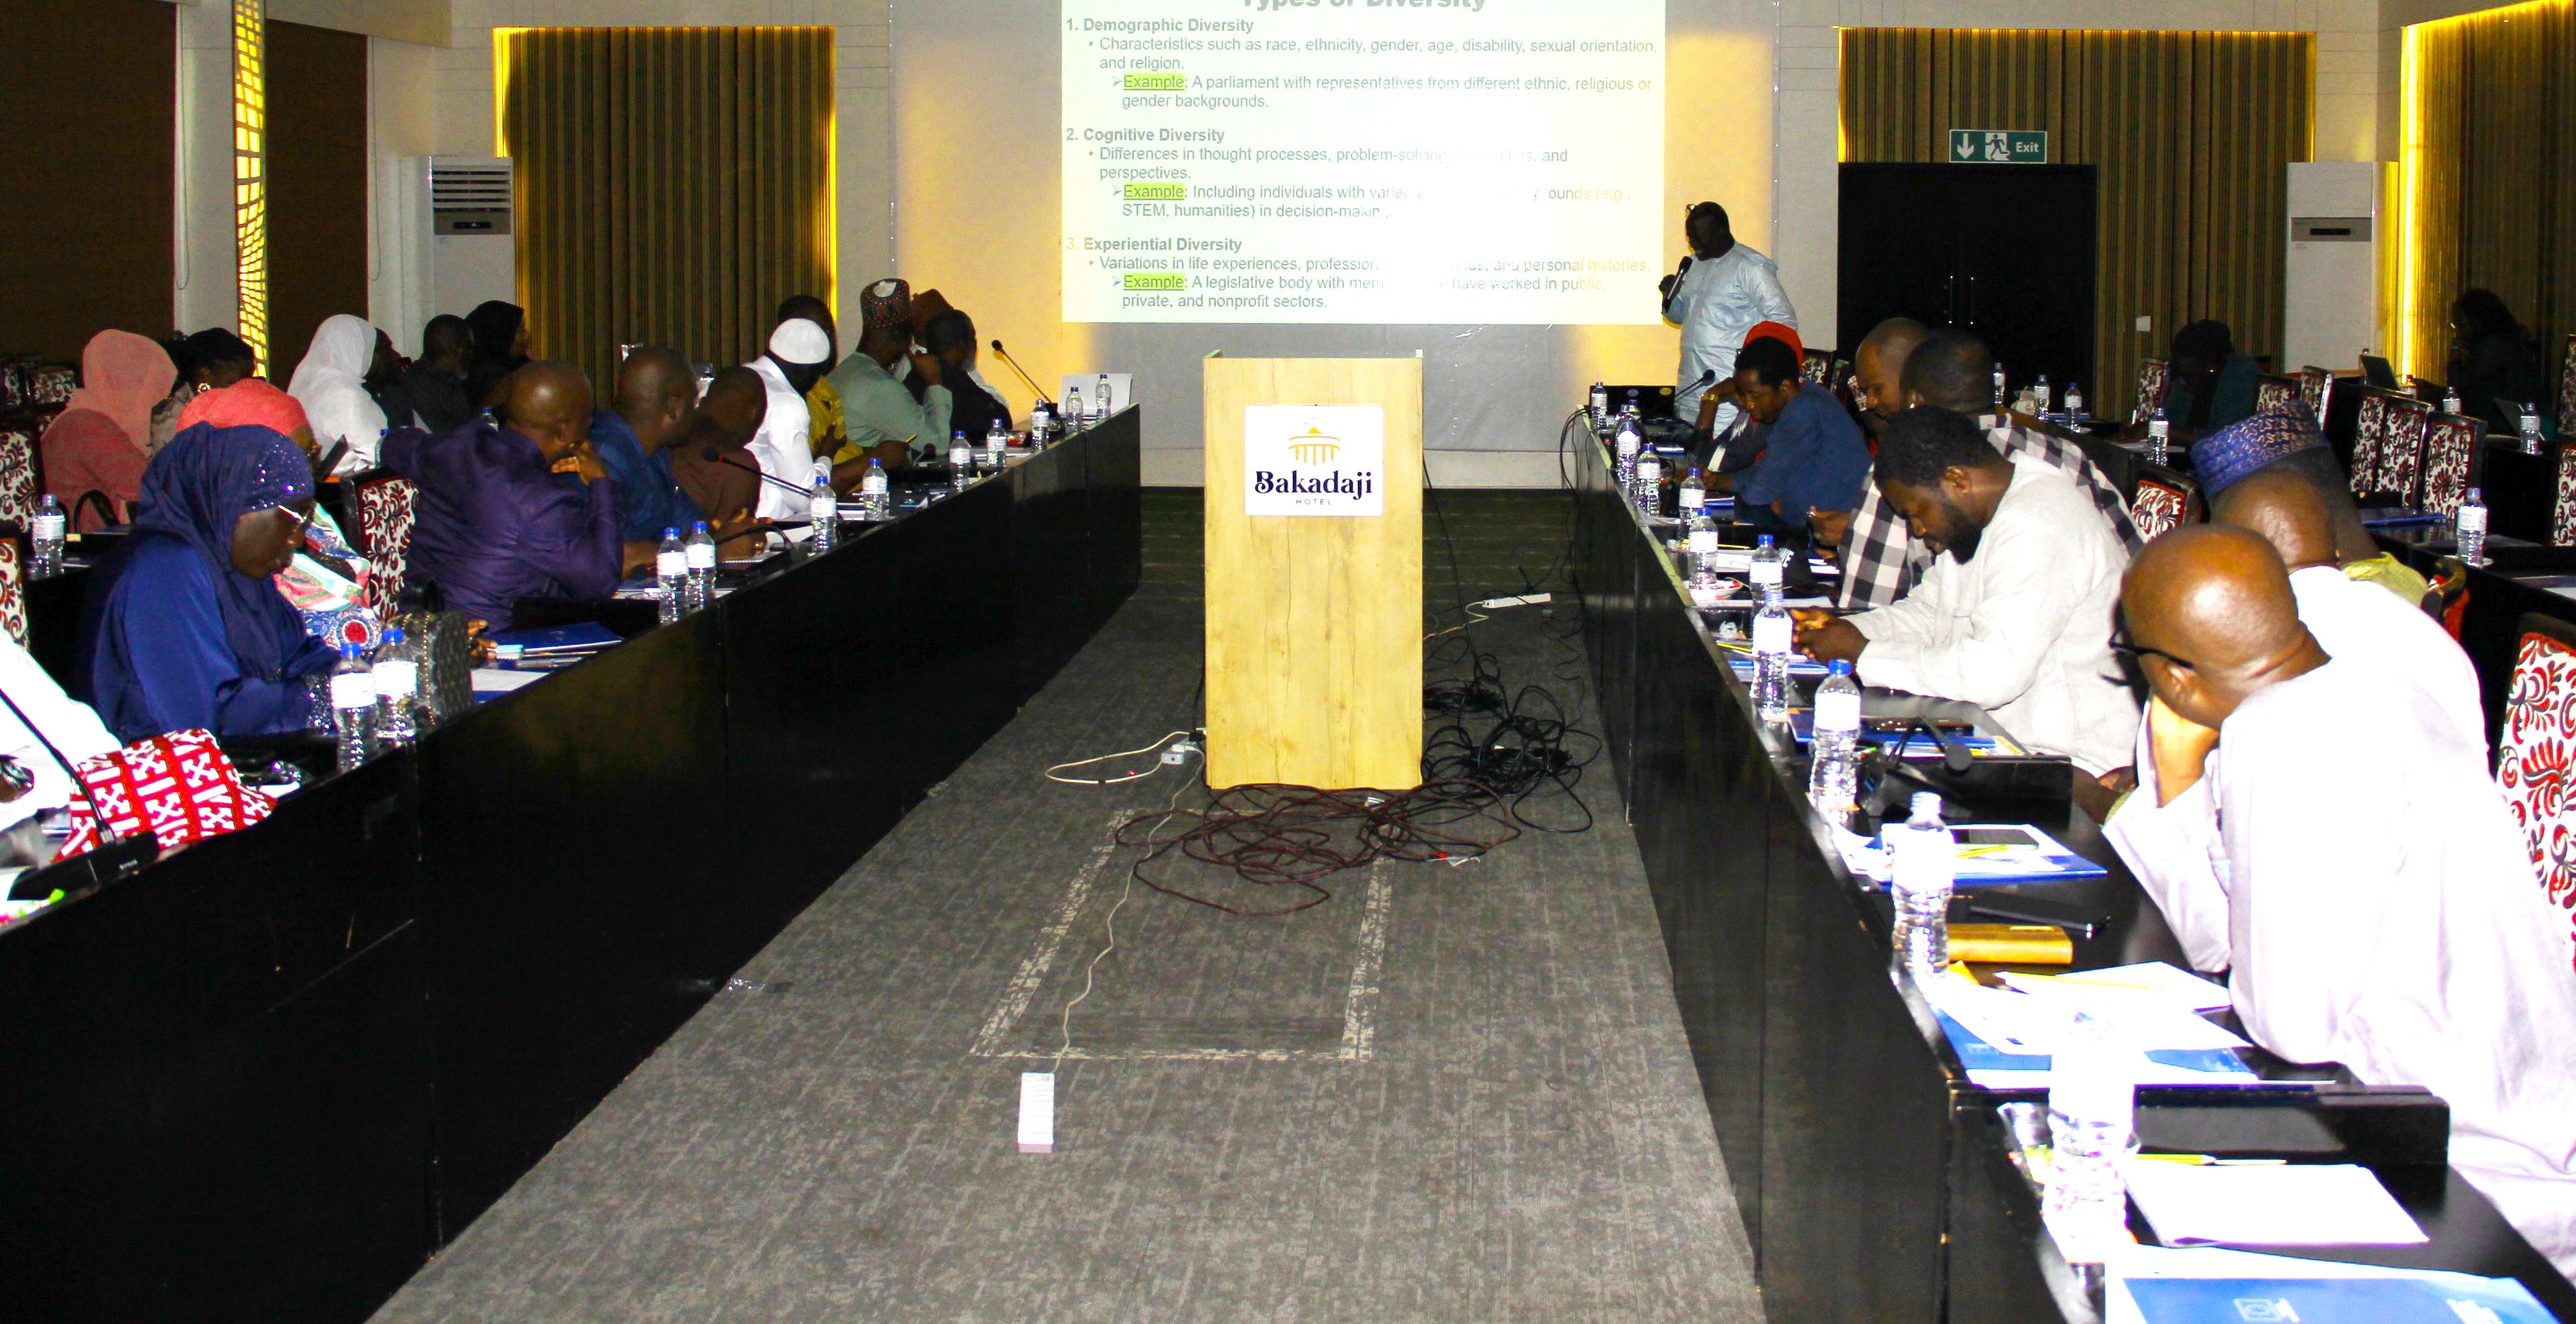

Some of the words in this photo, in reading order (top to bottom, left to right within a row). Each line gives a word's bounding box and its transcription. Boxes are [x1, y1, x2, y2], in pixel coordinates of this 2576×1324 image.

[1066, 18, 1079, 31] 1.
[1084, 18, 1183, 34] Demographic
[1188, 18, 1254, 34] Diversity
[1099, 37, 1204, 50] Characteristics
[1208, 37, 1241, 50] such
[1245, 41, 1261, 50] as
[1266, 41, 1300, 52] race,
[1305, 38, 1365, 54] ethnicity,
[1371, 39, 1422, 54] gender,
[1428, 41, 1458, 54] age,
[1462, 39, 1525, 54] disability,
[1530, 39, 1575, 52] sexual
[1580, 39, 1658, 54] orientation,
[1100, 57, 1125, 69] and
[1130, 57, 1184, 71] religion.
[1123, 75, 1188, 91] Example:
[1192, 75, 1202, 88] A
[1206, 75, 1280, 91] parliament
[1283, 75, 1311, 88] with
[1316, 76, 1423, 91] representatives
[1428, 76, 1459, 89] from
[1464, 76, 1520, 89] different
[1525, 76, 1571, 91] ethnic,
[1575, 77, 1634, 92] religious
[1638, 80, 1652, 90] or
[1123, 94, 1171, 110] gender
[1175, 94, 1269, 110] backgrounds.
[1066, 127, 1078, 140] 2.
[1084, 128, 1155, 144] Cognitive
[1159, 128, 1225, 144] Diversity
[1100, 146, 1179, 160] Differences
[1183, 147, 1195, 160] in
[1200, 147, 1252, 163] thought
[1256, 150, 1331, 163] processes,
[1543, 149, 1567, 161] and
[2016, 142, 2039, 153] Exit
[1100, 166, 1191, 179] perspectives.
[1123, 183, 1187, 201] Example:
[1194, 185, 1255, 200] Including
[1260, 185, 1333, 198] individuals
[1337, 186, 1364, 198] with
[1123, 203, 1169, 217] STEM,
[1174, 203, 1256, 219] humanities)
[1260, 204, 1271, 217] in
[1066, 237, 1079, 250] 3.
[1084, 237, 1172, 253] Experiential
[1176, 238, 1242, 253] Diversity
[1100, 256, 1167, 269] Variations
[1173, 256, 1183, 269] in
[1189, 256, 1209, 269] life
[1213, 256, 1300, 273] experiences,
[1524, 259, 1583, 273] personal
[1123, 274, 1187, 292] Example:
[1191, 275, 1202, 288] A
[1206, 275, 1274, 291] legislative
[1279, 276, 1312, 291] body
[1317, 276, 1344, 289] with
[1546, 277, 1556, 290] in
[1123, 294, 1173, 309] private,
[1178, 294, 1203, 307] and
[1209, 294, 1269, 310] nonprofit
[1273, 294, 1328, 307] sectors.
[1255, 470, 1372, 501] Bakadaji
